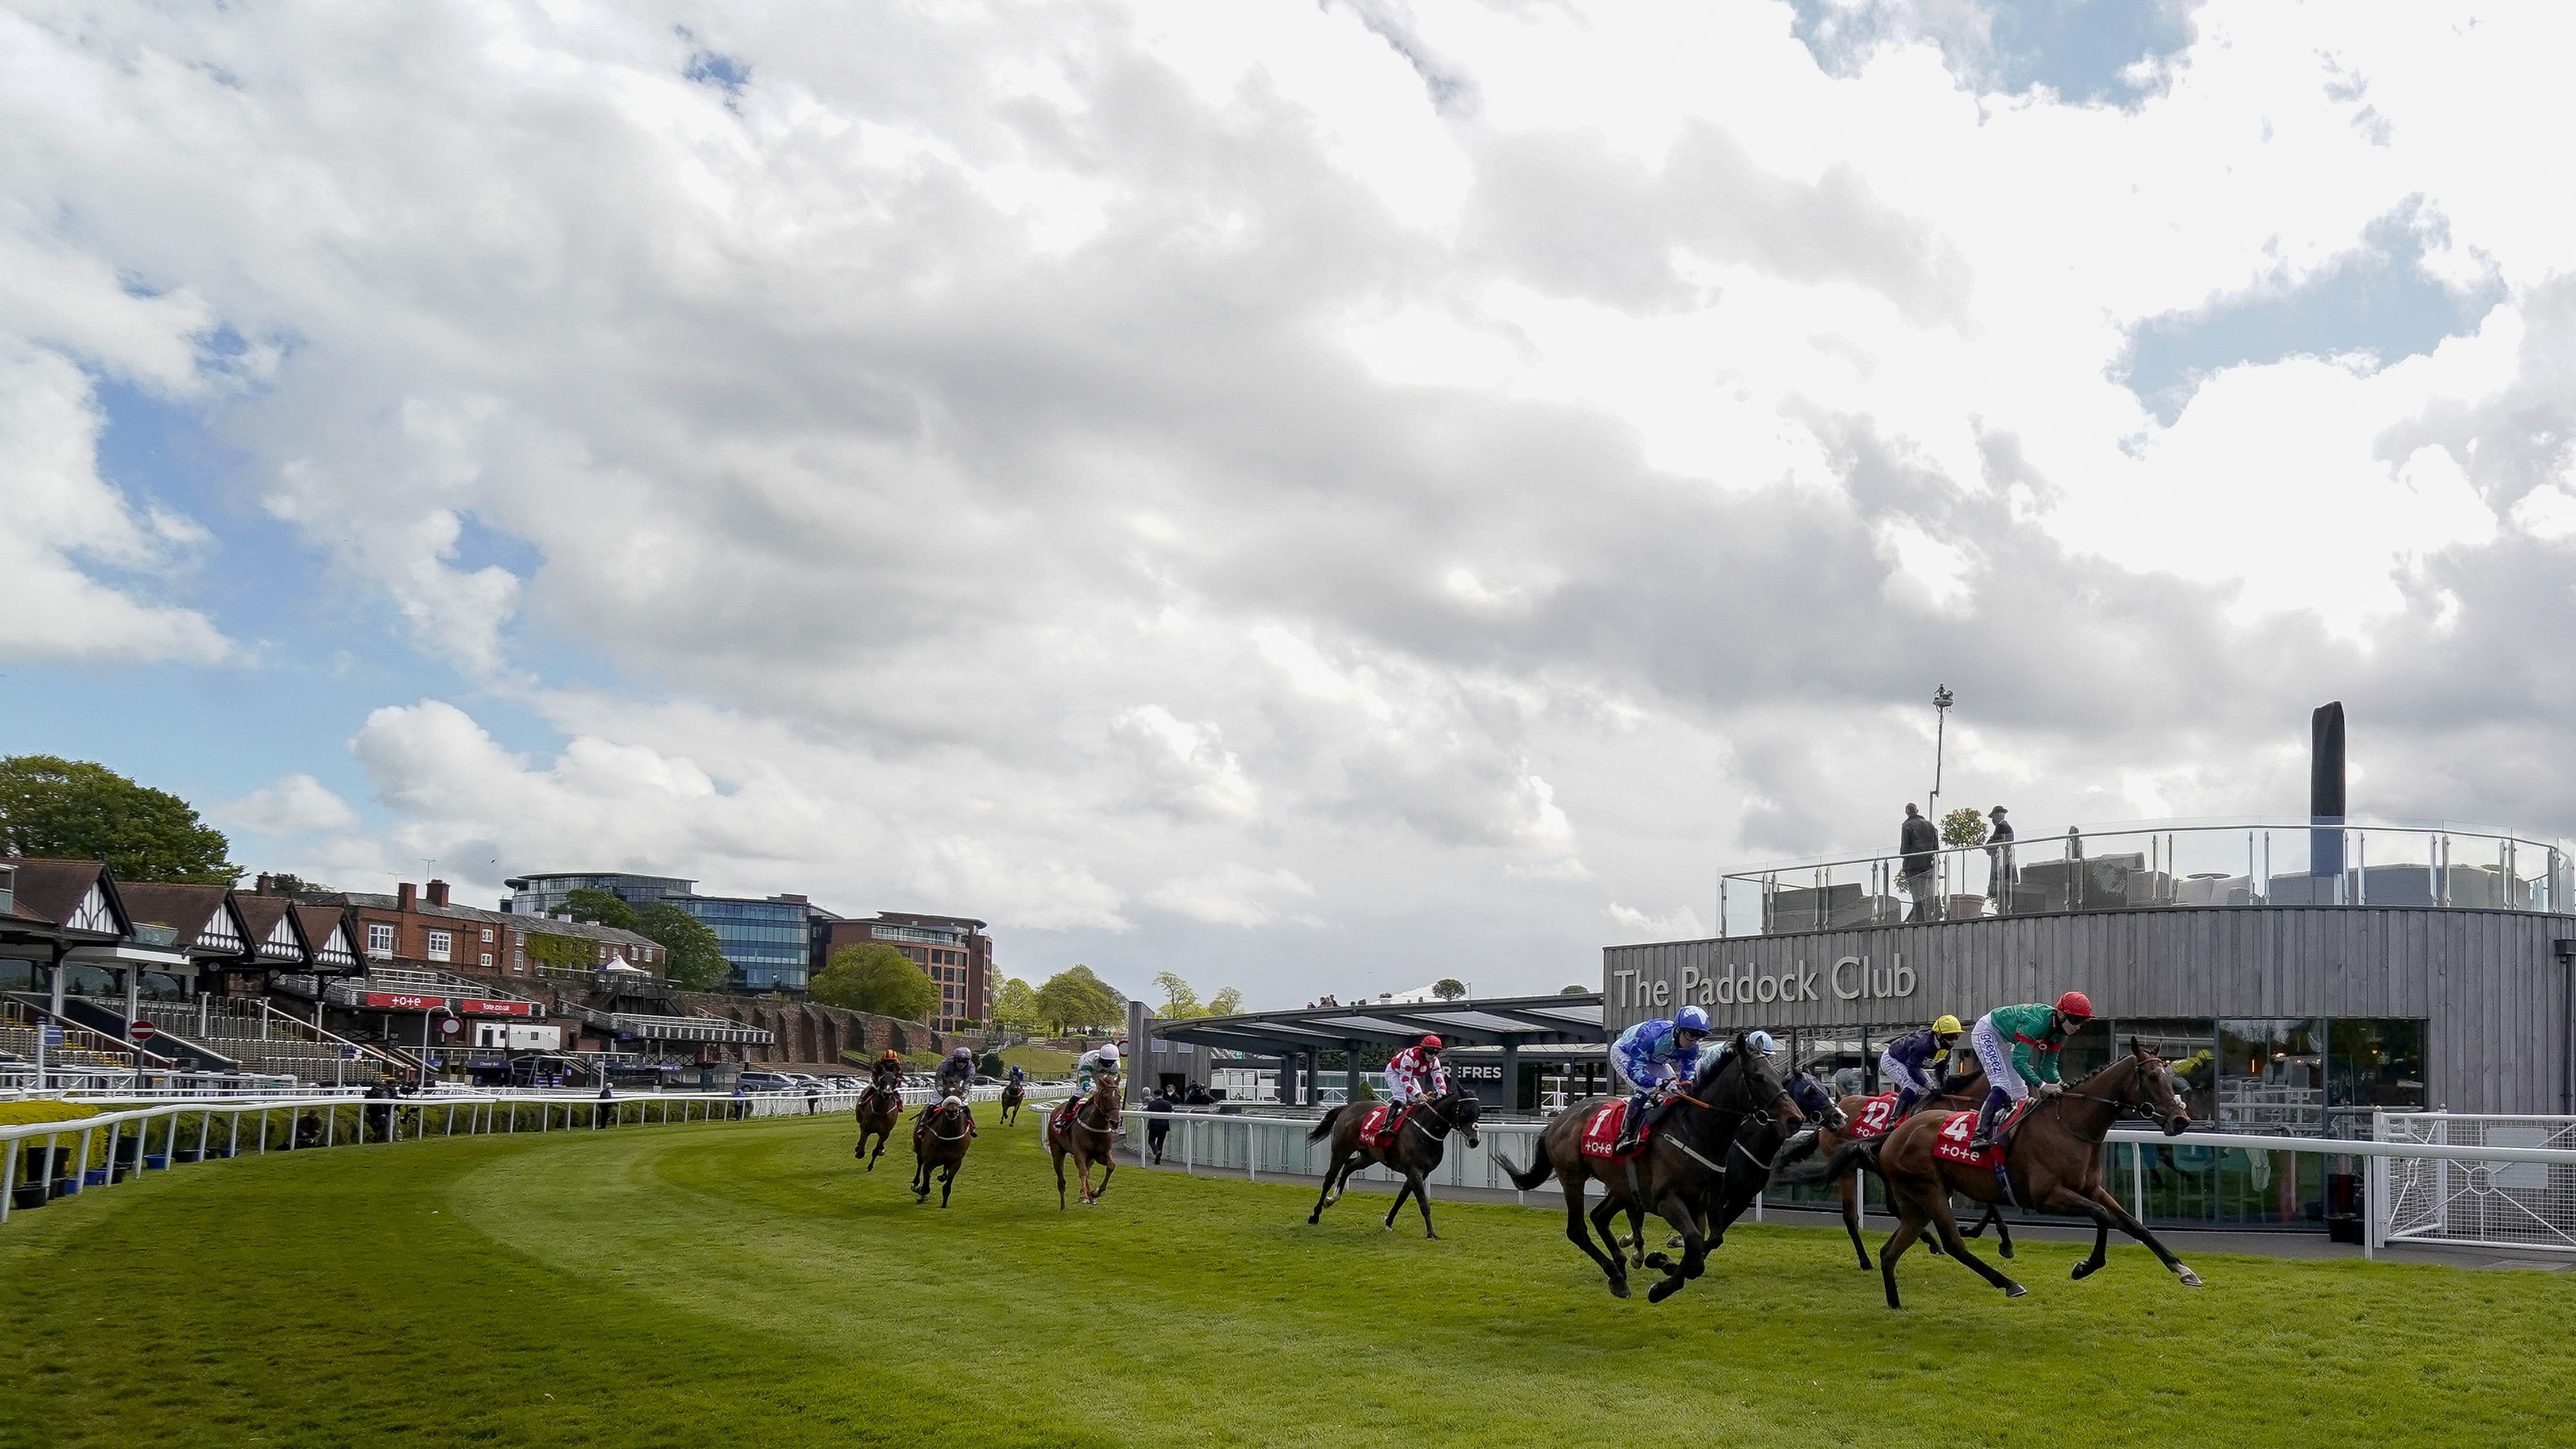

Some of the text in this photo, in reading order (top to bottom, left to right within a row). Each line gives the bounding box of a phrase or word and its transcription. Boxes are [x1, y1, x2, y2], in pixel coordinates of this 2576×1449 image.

[1613, 952, 1917, 1007] The Paddock Club
[1980, 1034, 2002, 1074] geegeez
[1863, 1101, 1890, 1130] 12
[1944, 1114, 1970, 1142] 4
